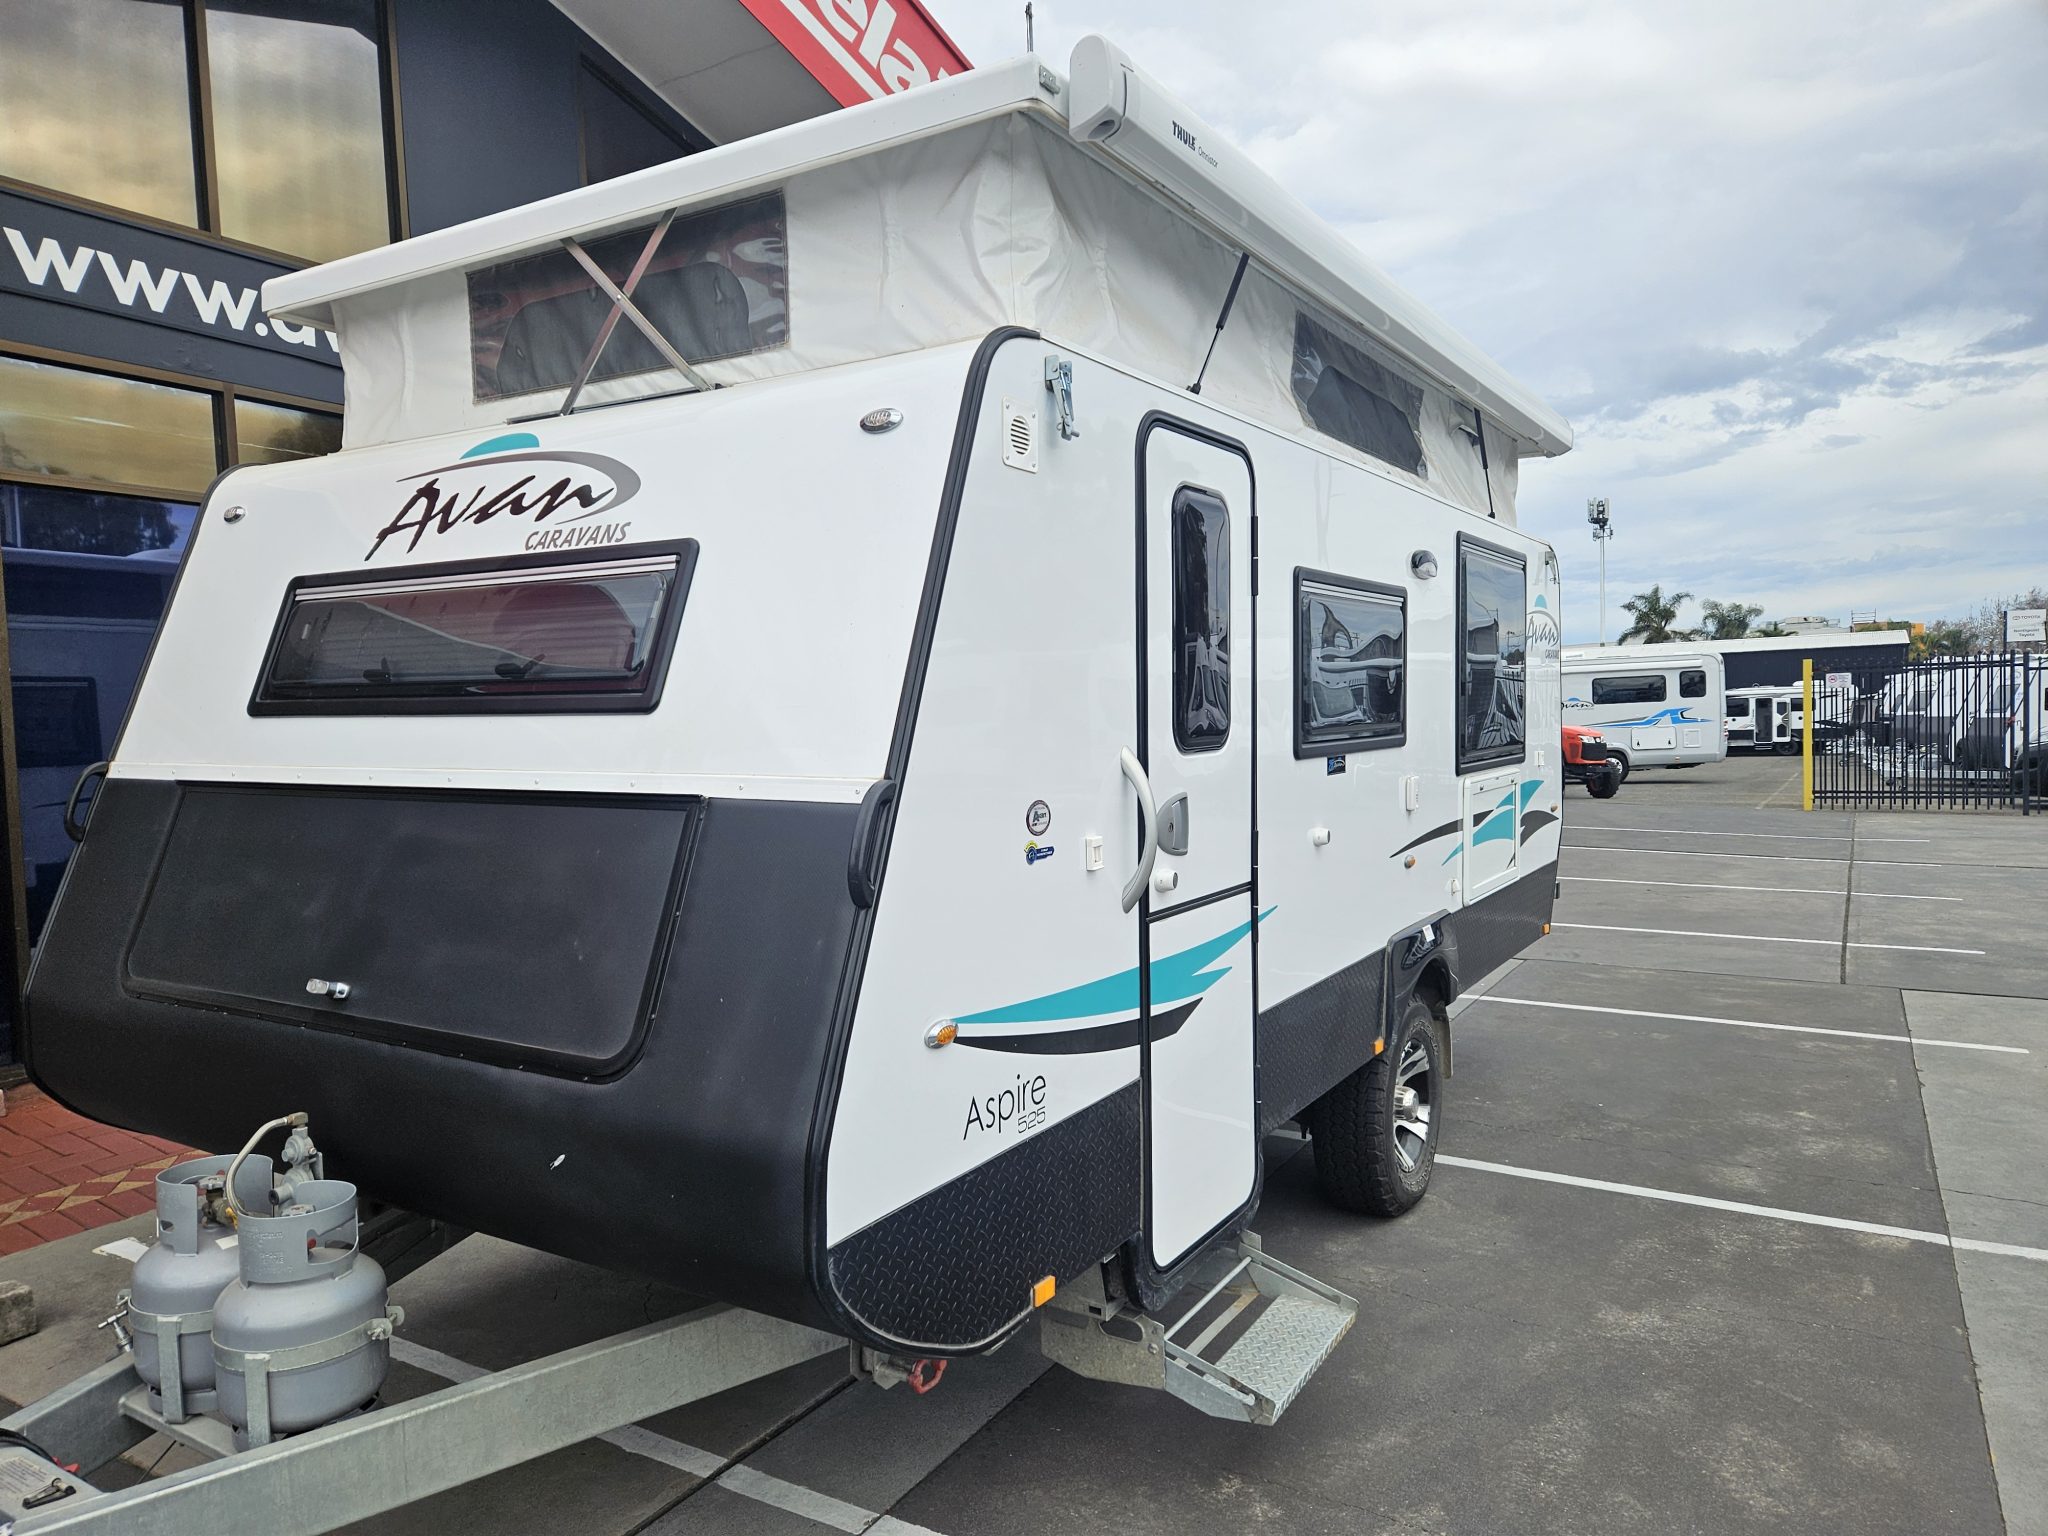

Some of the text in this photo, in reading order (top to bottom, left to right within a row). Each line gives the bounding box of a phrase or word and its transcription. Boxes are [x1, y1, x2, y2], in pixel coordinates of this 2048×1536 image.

[1172, 120, 1196, 151] THULE
[364, 475, 614, 561] Avan
[525, 521, 632, 551] CARAVANS
[1526, 615, 1557, 652] Avan
[963, 1073, 1046, 1141] Aspire
[1017, 1105, 1046, 1134] 525
